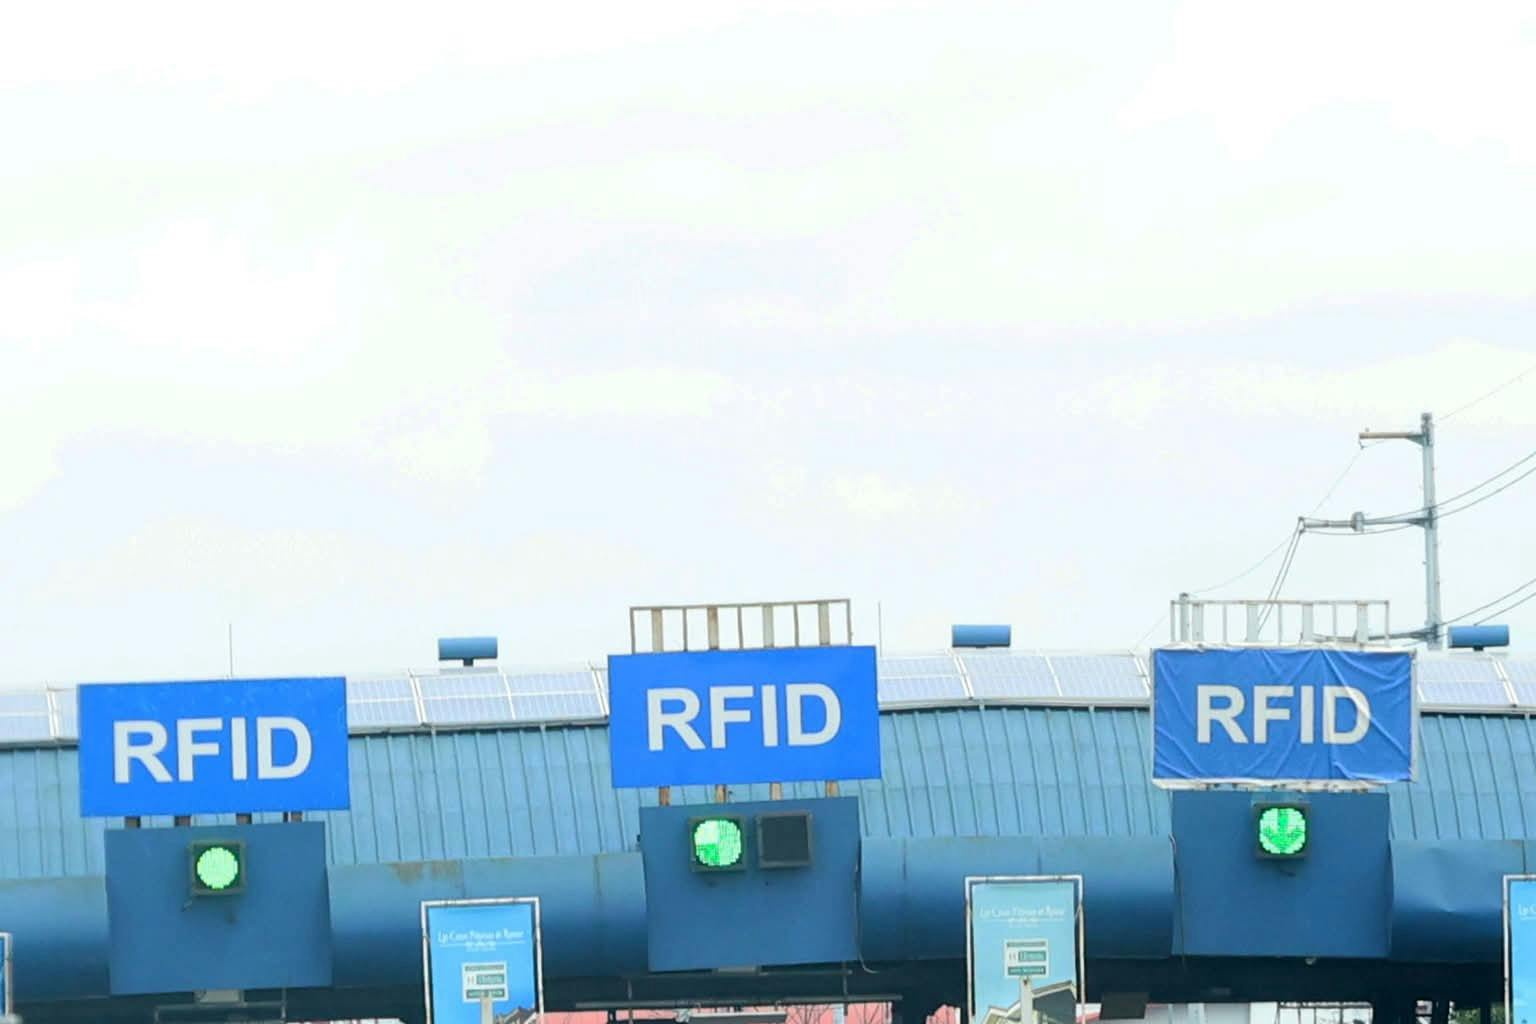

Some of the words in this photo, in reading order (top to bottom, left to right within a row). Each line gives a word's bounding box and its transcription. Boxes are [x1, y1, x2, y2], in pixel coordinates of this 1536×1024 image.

[647, 683, 841, 752] RFID
[1197, 684, 1371, 745] RFID
[113, 715, 312, 783] RFID
